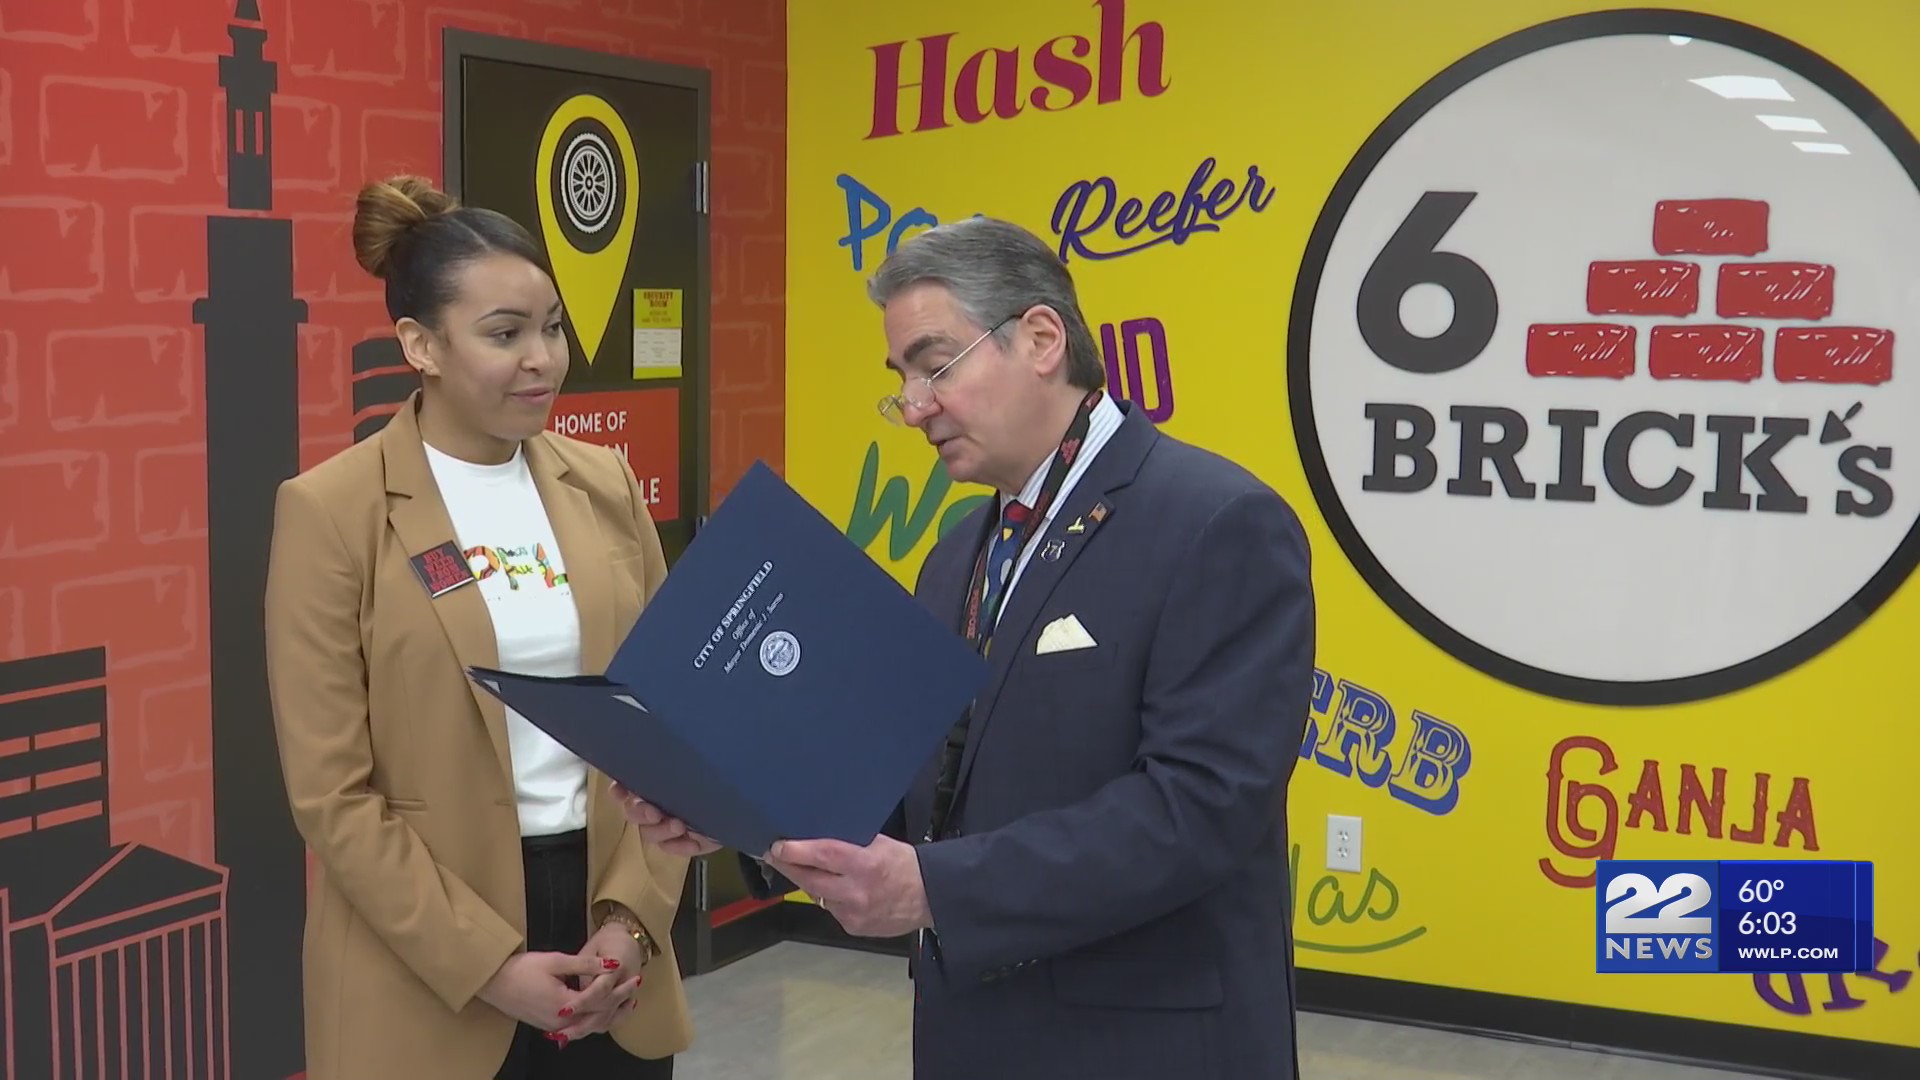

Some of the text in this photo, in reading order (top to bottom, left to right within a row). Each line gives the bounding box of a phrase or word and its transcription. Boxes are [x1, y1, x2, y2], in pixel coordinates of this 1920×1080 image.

[862, 0, 1171, 140] Hash
[1050, 157, 1276, 264] Reefer
[1357, 191, 1499, 374] 6
[554, 410, 628, 436] HOME OF
[694, 561, 773, 668] CITY OF SPRINGFIELD
[1538, 735, 1820, 888] GANJA
